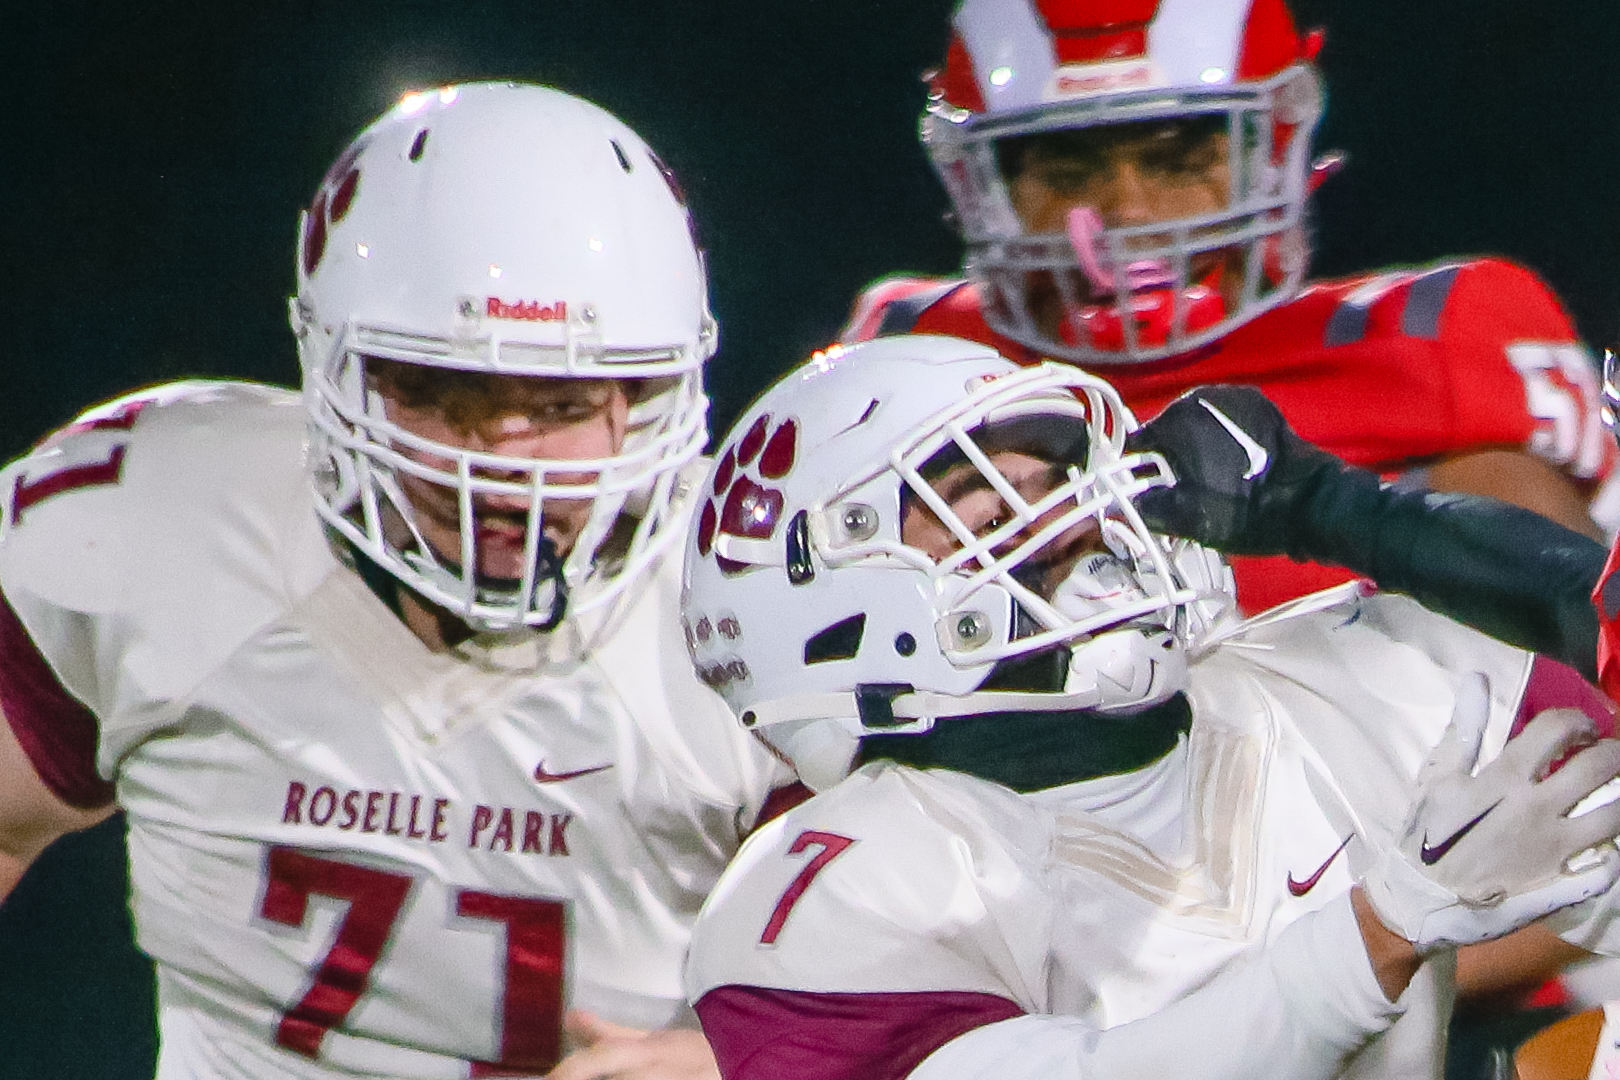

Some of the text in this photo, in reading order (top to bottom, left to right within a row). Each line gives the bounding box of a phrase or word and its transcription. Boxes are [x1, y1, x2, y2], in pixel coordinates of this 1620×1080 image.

[487, 297, 567, 321] Riddell
[282, 781, 574, 857] ROSELLE PARK
[758, 831, 858, 947] 7
[257, 845, 573, 1080] 71
